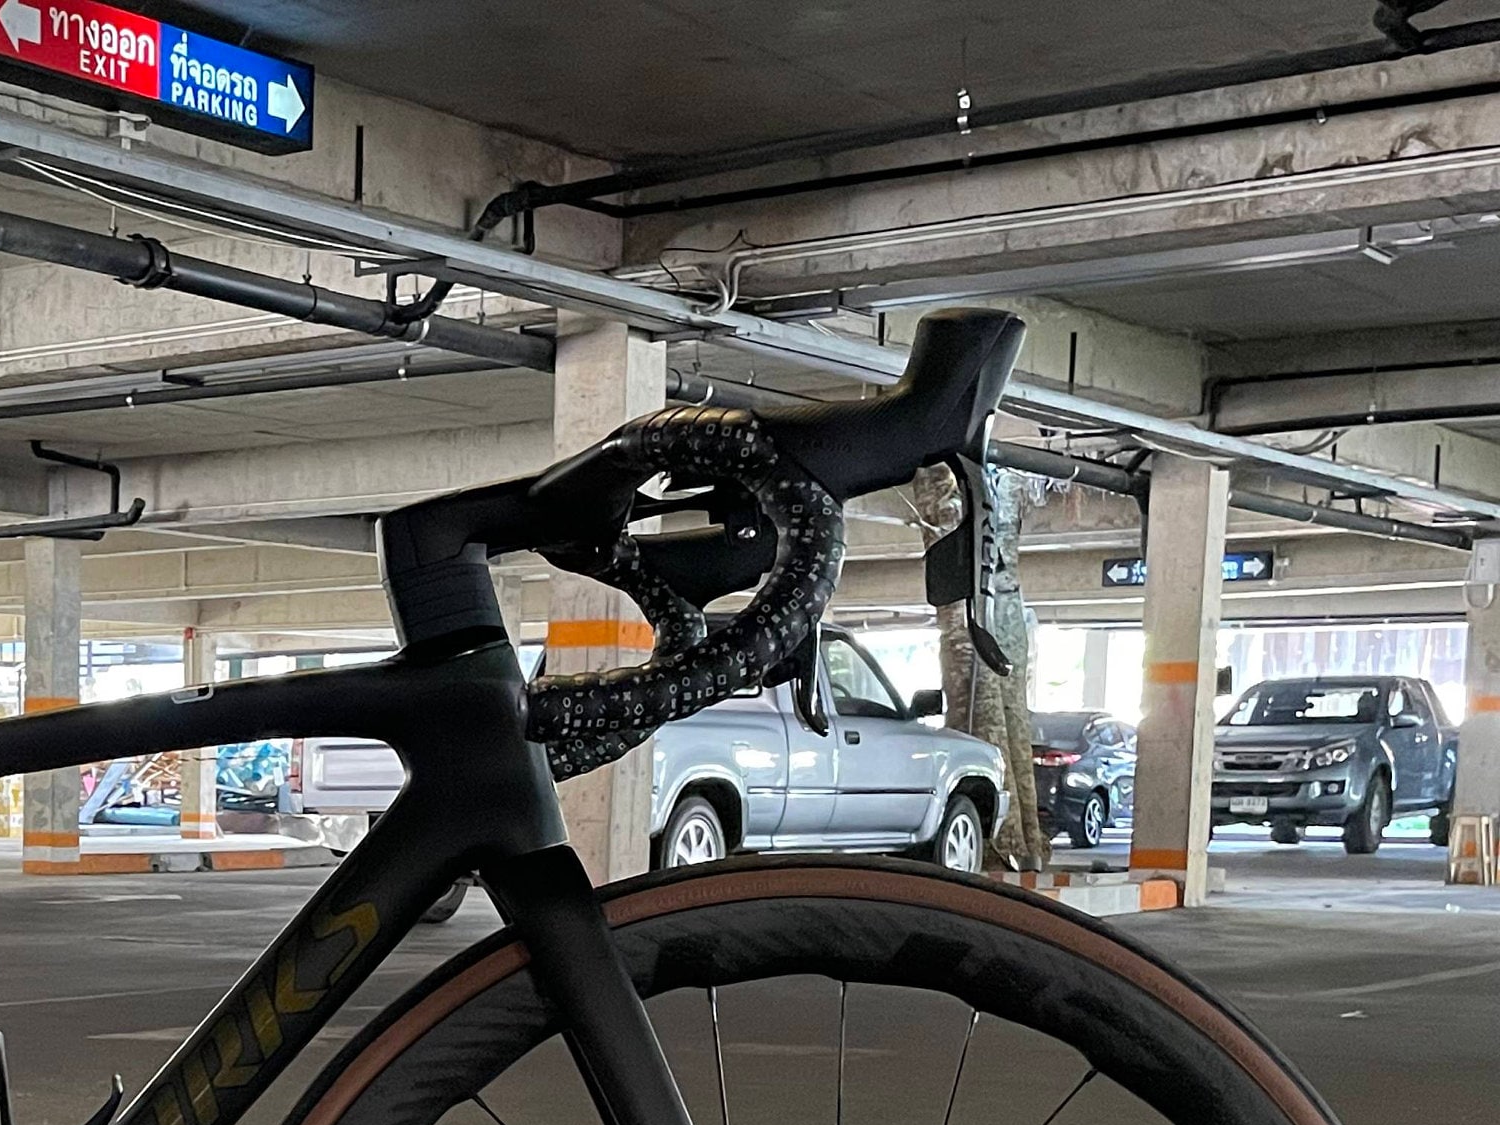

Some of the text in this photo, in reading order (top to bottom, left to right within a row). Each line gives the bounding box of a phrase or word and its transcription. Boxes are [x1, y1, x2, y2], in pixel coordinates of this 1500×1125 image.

[50, 7, 155, 66] ทางออก
[79, 51, 130, 84] EXIT
[169, 32, 258, 99] ที่จอดรถ
[171, 84, 259, 127] PARKING
